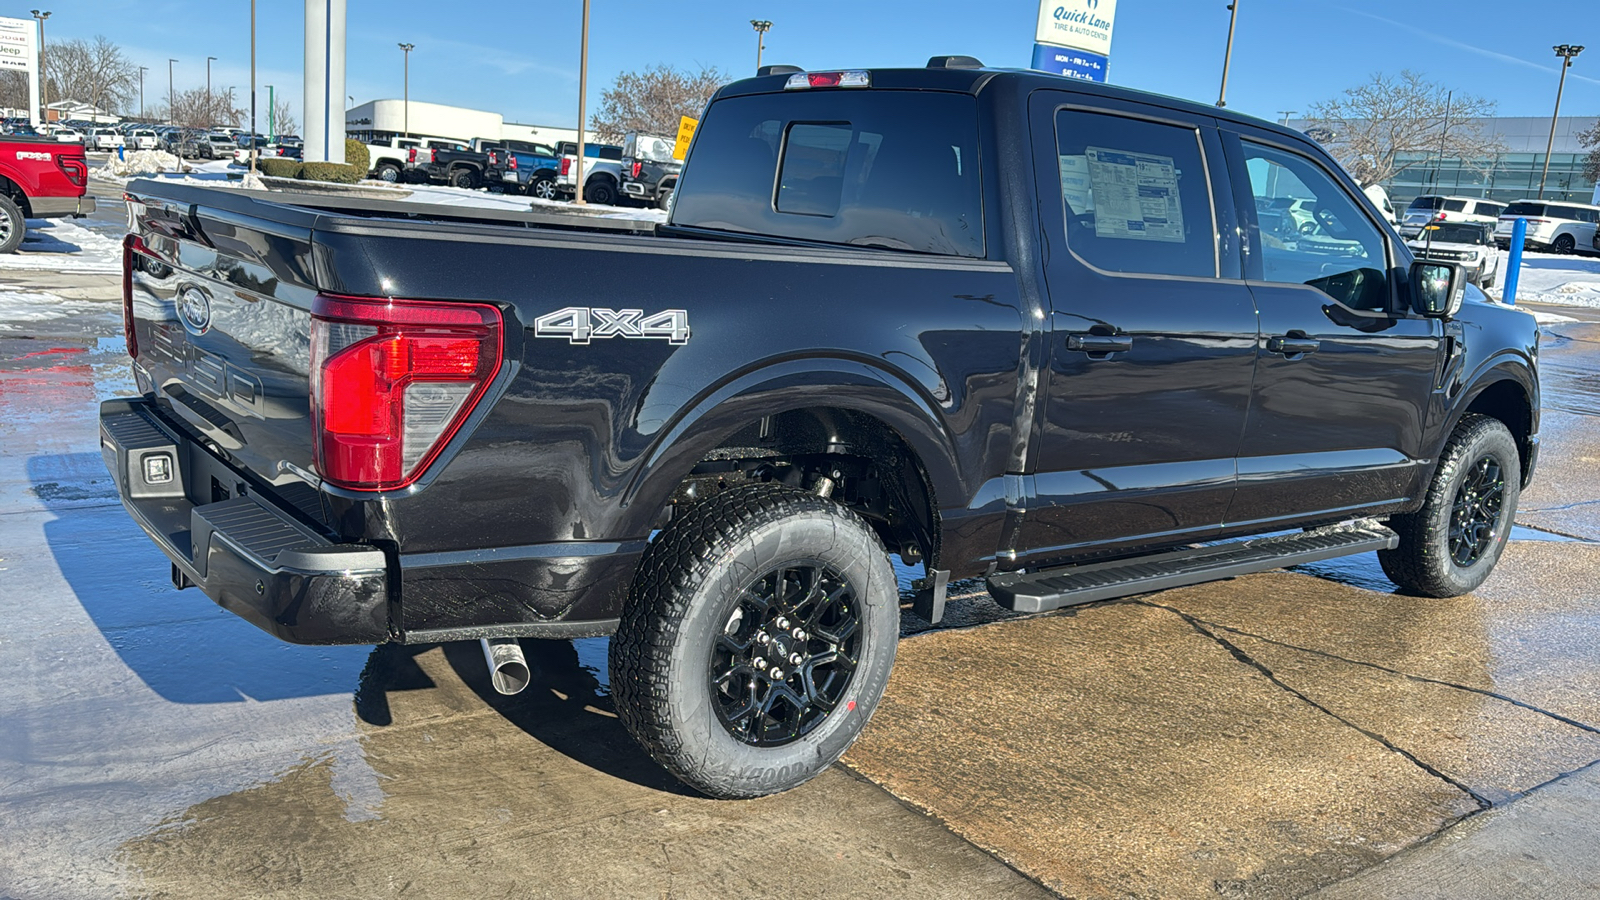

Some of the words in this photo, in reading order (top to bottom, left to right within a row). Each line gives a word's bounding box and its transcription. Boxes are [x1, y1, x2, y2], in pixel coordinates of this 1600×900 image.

[1053, 6, 1088, 24] Quick
[1088, 13, 1111, 31] Lane
[1054, 22, 1069, 32] TIRE
[1074, 27, 1091, 36] AUTO
[1091, 31, 1108, 41] CENTER
[1055, 54, 1069, 63] MON
[535, 307, 691, 346] 4X4
